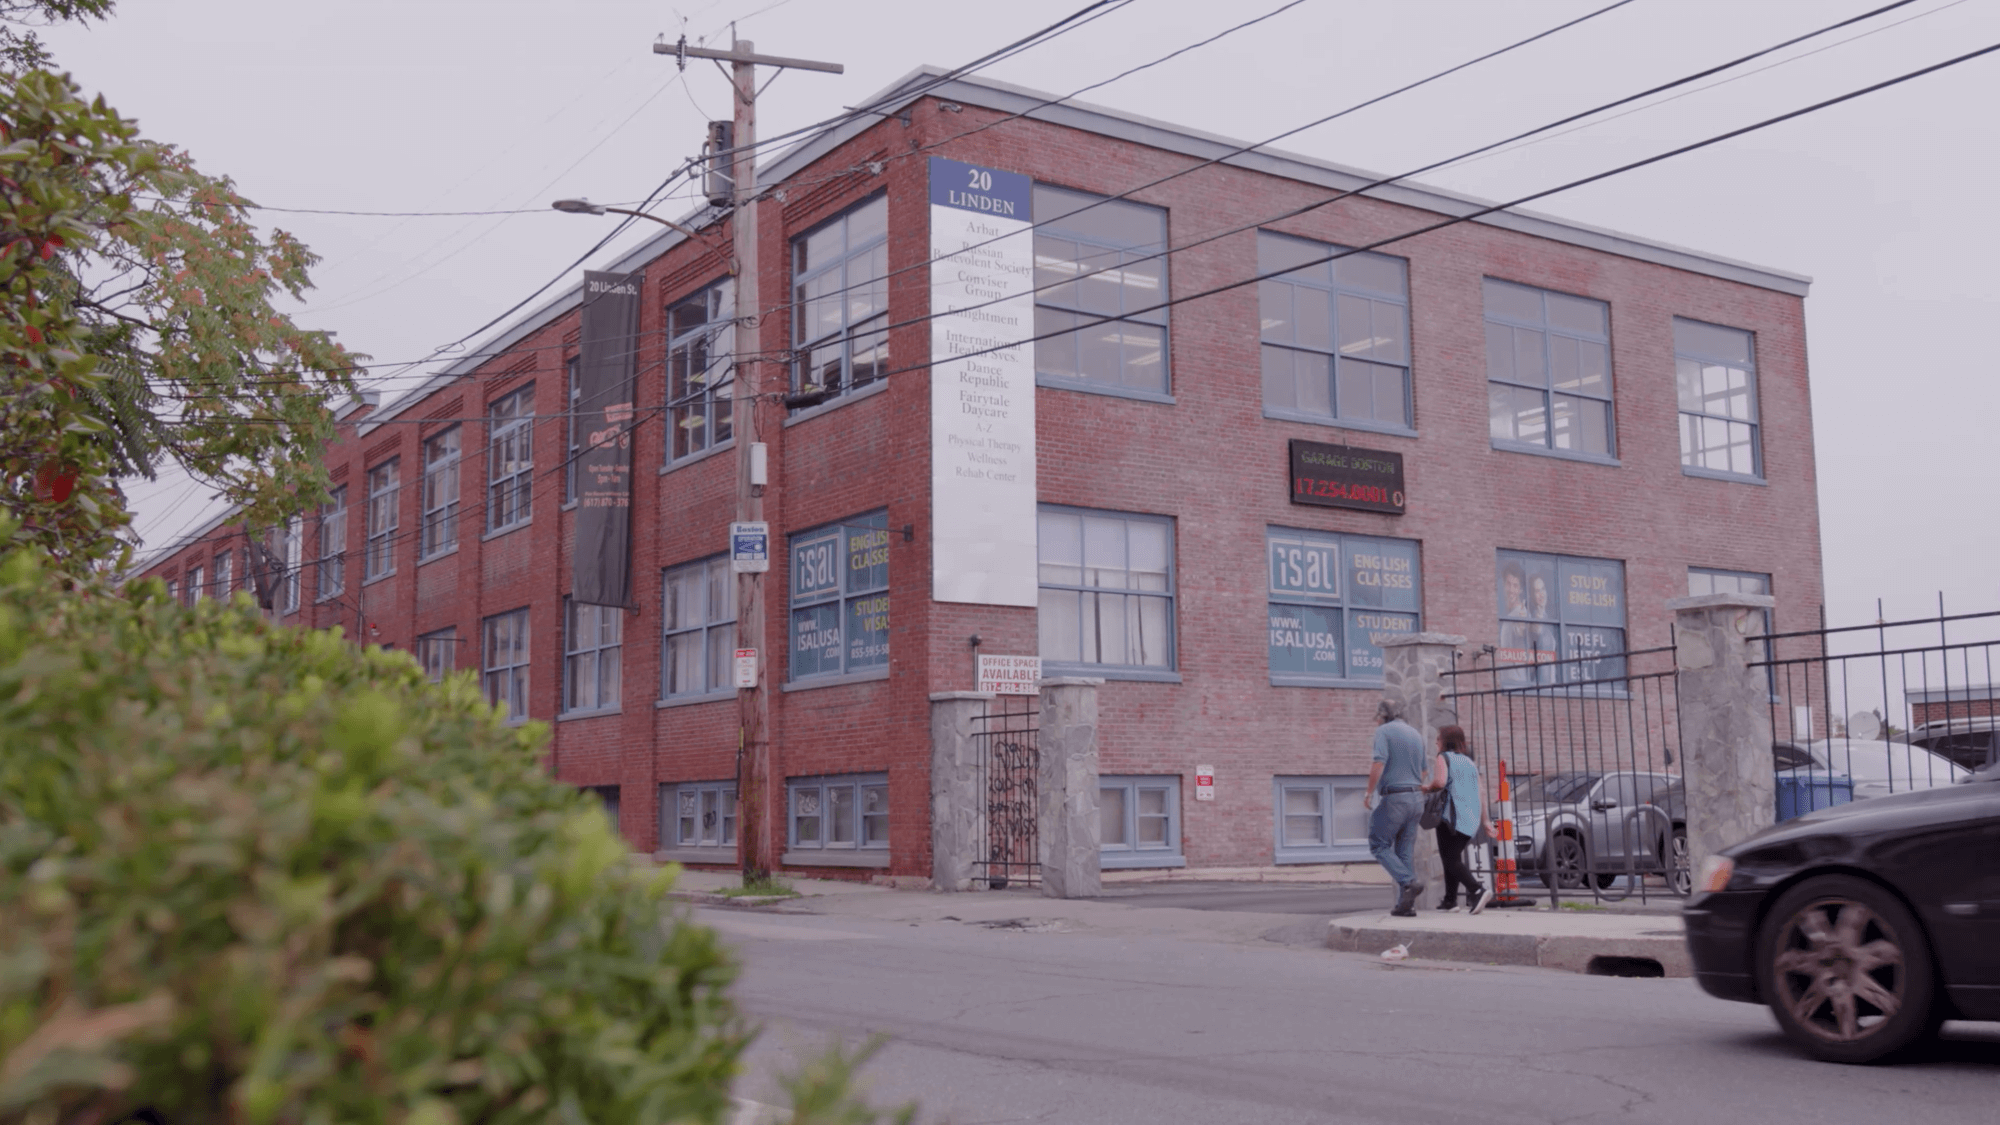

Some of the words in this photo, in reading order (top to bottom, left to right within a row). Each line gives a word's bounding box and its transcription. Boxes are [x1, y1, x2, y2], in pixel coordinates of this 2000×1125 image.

[968, 168, 992, 191] 20
[949, 189, 1015, 215] LINDEN
[966, 221, 999, 237] Arbat
[962, 241, 1003, 259] Russian
[933, 248, 991, 269] Benevolent
[994, 261, 1031, 278] Society
[589, 281, 599, 292] 20
[958, 270, 1009, 289] Conviser
[965, 284, 1002, 300] Group
[948, 304, 1019, 326] Enlightment
[946, 329, 1021, 351] International
[949, 342, 989, 358] Health
[991, 349, 1019, 363] Svcs.
[966, 360, 1002, 376] Dance
[959, 371, 1009, 389] Republic
[959, 390, 1010, 407] Fairytale
[962, 402, 1008, 419] Daycare
[976, 423, 993, 433] A-Z
[948, 434, 985, 447] Physical
[987, 438, 1021, 454] Therapy
[967, 452, 1008, 466] Wellness
[1301, 450, 1348, 469] GARAGE
[955, 466, 984, 479] Rehab
[986, 470, 1016, 482] Center
[850, 530, 888, 553] ENGLIS
[851, 548, 889, 570] CLASSE
[1353, 554, 1410, 572] ENGLISH
[1357, 571, 1412, 589] CLASSES
[1570, 574, 1608, 590] STUDY
[855, 597, 889, 616] STUDE
[1569, 591, 1616, 607] ENGLISH
[863, 616, 889, 633] VISA
[1357, 614, 1413, 631] STUDENT
[1567, 632, 1606, 648] TOEFL
[982, 657, 1011, 667] OFFICE
[1013, 659, 1039, 668] SPACE
[1313, 650, 1336, 662] .COM
[982, 668, 1039, 680] AVAILABLE
[1570, 666, 1592, 680] ESL
